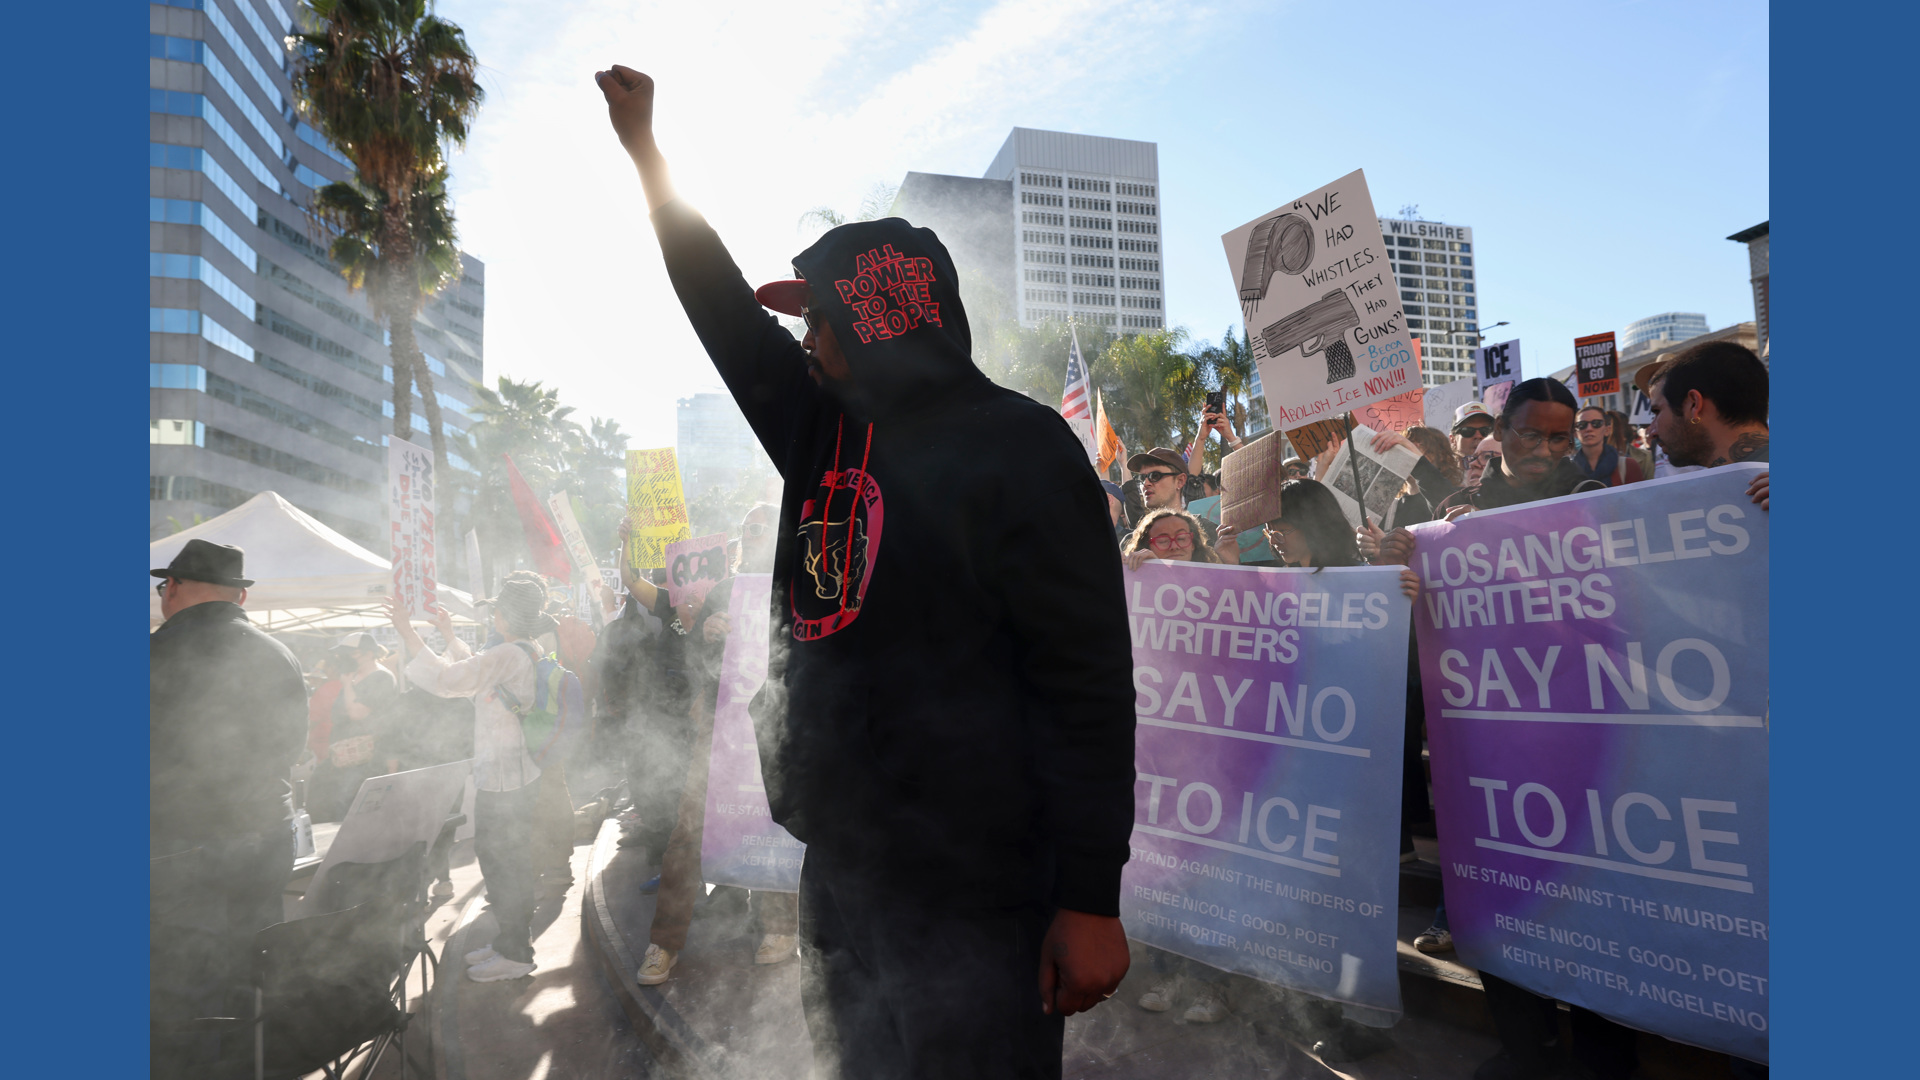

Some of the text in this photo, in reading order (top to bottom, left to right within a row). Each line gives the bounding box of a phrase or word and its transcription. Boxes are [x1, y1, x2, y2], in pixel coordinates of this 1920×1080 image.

[1325, 224, 1354, 248] HAD
[1390, 221, 1464, 240] WILSHIRE
[835, 257, 936, 304] POWER
[856, 244, 904, 274] ALL
[1302, 247, 1380, 288] WHISTLES.
[852, 283, 931, 320] TO THE
[1345, 273, 1383, 298] THEY
[1365, 299, 1389, 315] HAD
[1369, 349, 1411, 373] GOOD
[1484, 344, 1511, 379] ICE
[1577, 342, 1614, 357] TRUMP
[1582, 354, 1611, 369] MUST
[1590, 368, 1604, 380] GO
[1279, 368, 1407, 427] ABOLISH ICE NOW!!!
[1584, 380, 1614, 394] NOW!
[400, 473, 411, 523] DUE
[420, 452, 437, 615] NO PERSON
[1421, 504, 1750, 590] LOS ANGELES
[391, 521, 405, 605] LAW
[402, 533, 416, 617] PROCESS
[1131, 581, 1389, 630] LOS ANGELES
[1425, 573, 1616, 629] WRITERS
[1129, 615, 1300, 664] WRITERS
[1439, 638, 1731, 713] SAY NO
[1133, 666, 1356, 742] SAY NO
[716, 803, 772, 817] WE STAN
[1136, 772, 1341, 865] TO ICE
[1469, 776, 1748, 877] TO ICE
[742, 855, 776, 867] KEITH
[1129, 848, 1384, 918] STAND AGAINST THE MURDERS OF
[1134, 885, 1339, 949] RENÉE NICOLE GOOD, POET
[1453, 862, 1769, 941] WE STAND AGAINST THE MURDER
[1137, 910, 1334, 974] KEITH PORTER, ANGELENO
[1495, 913, 1768, 996] RENÉE NICOLE GOOD, POET
[1502, 944, 1767, 1032] KEITH PORTER, ANGELENO
